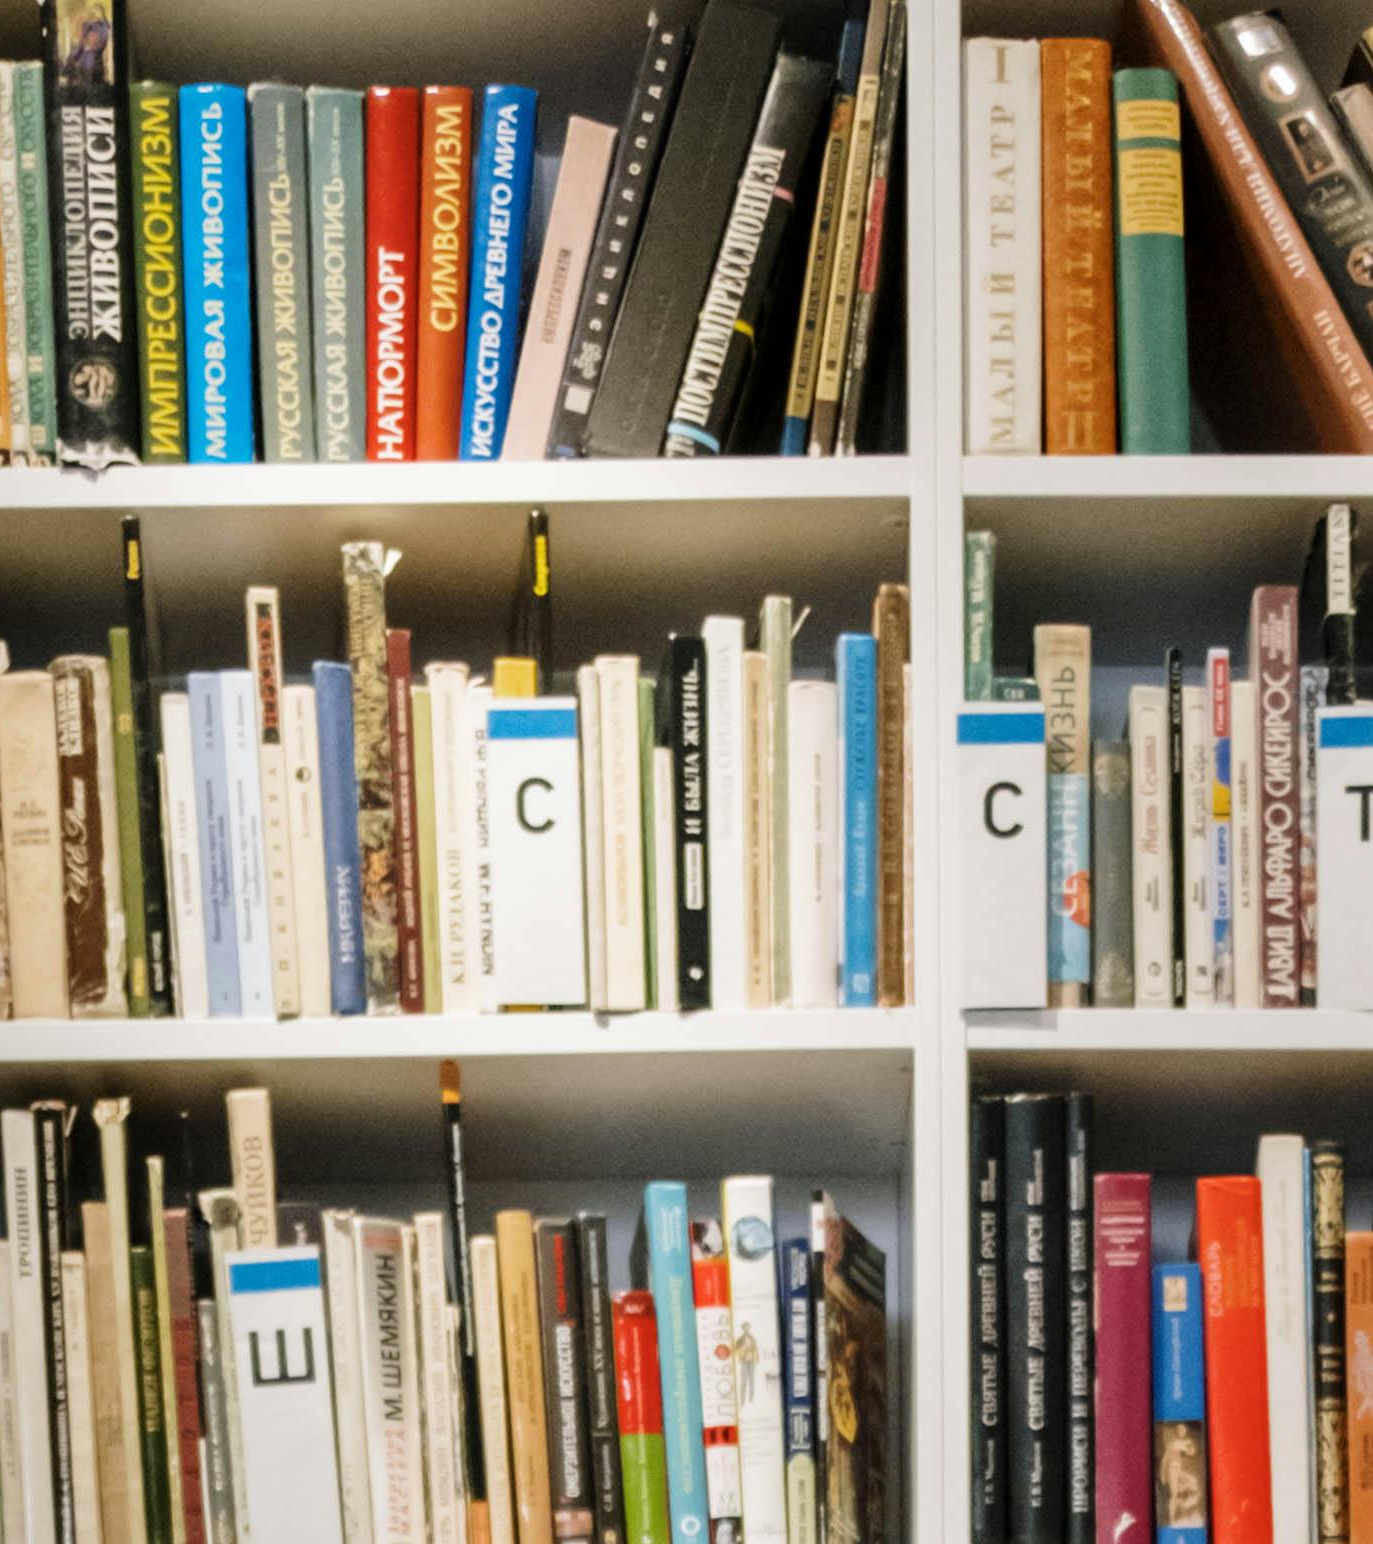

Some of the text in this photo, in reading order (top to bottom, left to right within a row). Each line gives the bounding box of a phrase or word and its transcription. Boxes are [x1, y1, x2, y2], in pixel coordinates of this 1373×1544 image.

[61, 104, 89, 337] ЭНЦИКЛОПЕДИЯ
[87, 107, 121, 341] ЖИВОПИСИ
[142, 97, 178, 454] ИМПРЕССИОНИЗМ
[200, 102, 226, 456] МИРОВАЯ ЖИВОПИСЬ
[270, 173, 302, 458] РУССКАЯ ЖИВОПИСЬ
[322, 176, 349, 461] РУССКАЯ ЖИВОПИСЬ
[430, 103, 463, 332] СИМВОЛИЗМ
[471, 103, 520, 456] ИСКУССТВО ДРЕВНЕГО МИРА
[671, 148, 785, 424] ПОСТИМПРЕССИОНИЗМ
[988, 103, 1016, 442] МАЛЫЙ ТЕАТР
[1067, 251, 1094, 400] ТЕАТР
[378, 246, 407, 459] НАТЮРМОРТ
[517, 777, 554, 832] С
[683, 752, 703, 833] И БЫЛА
[984, 782, 1022, 838] С
[1051, 782, 1078, 917] СЕЗАНН
[1258, 673, 1296, 999] ДАВИД АЛЬФАРО СИКЕЙРОС
[12, 1167, 33, 1279] ТРОПИНИН
[243, 1134, 270, 1246] ЧУЙКОВ
[247, 1327, 316, 1387] Ш
[377, 1253, 403, 1422] М. ШЕМЯКИН
[554, 1324, 582, 1498] ОМЕРЗИТЕЛЬНОЕ ИСКУССТВО
[978, 1211, 999, 1427] СВЯТЫЕ ДРЕВНЕЙ РУСИ
[1026, 1215, 1045, 1431] СВЯТЫЕ ДРЕВНЕЙ РУСИ
